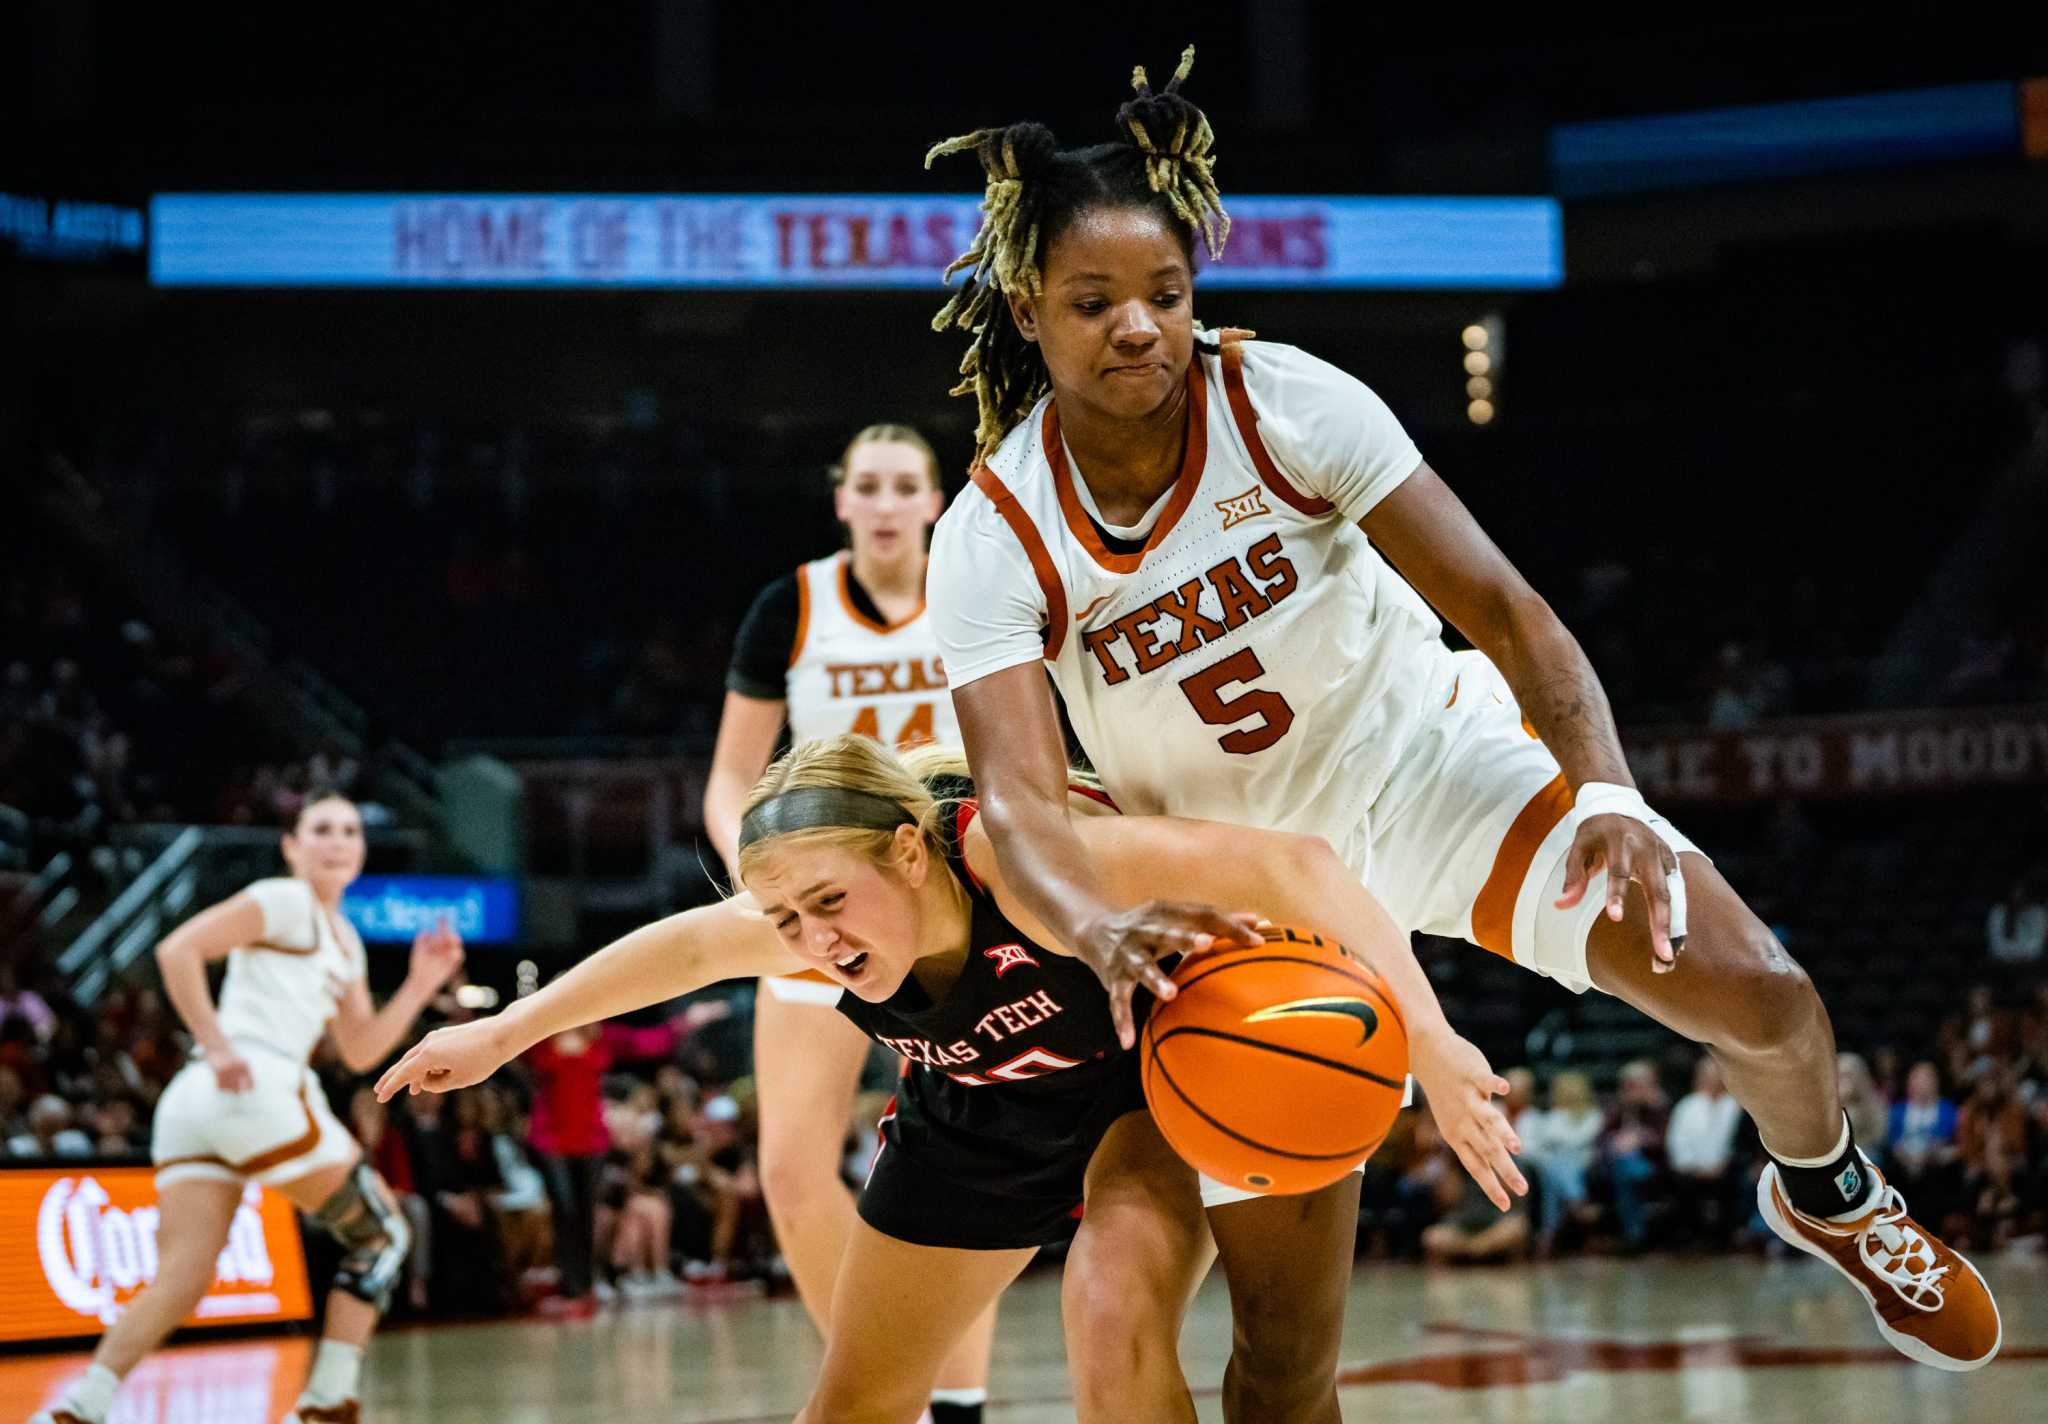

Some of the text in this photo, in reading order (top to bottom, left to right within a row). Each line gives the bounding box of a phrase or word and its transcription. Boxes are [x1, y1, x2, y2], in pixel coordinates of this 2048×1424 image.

[396, 205, 956, 273] HOME OF THE TEXAS
[1082, 532, 1298, 686] TEXAS
[825, 655, 949, 700] TEXAS
[1178, 646, 1295, 755] 5
[1742, 733, 1823, 791] TO
[874, 1031, 980, 1067] TEXAS
[973, 989, 1065, 1043] TECH
[37, 1176, 274, 1326] Cora
